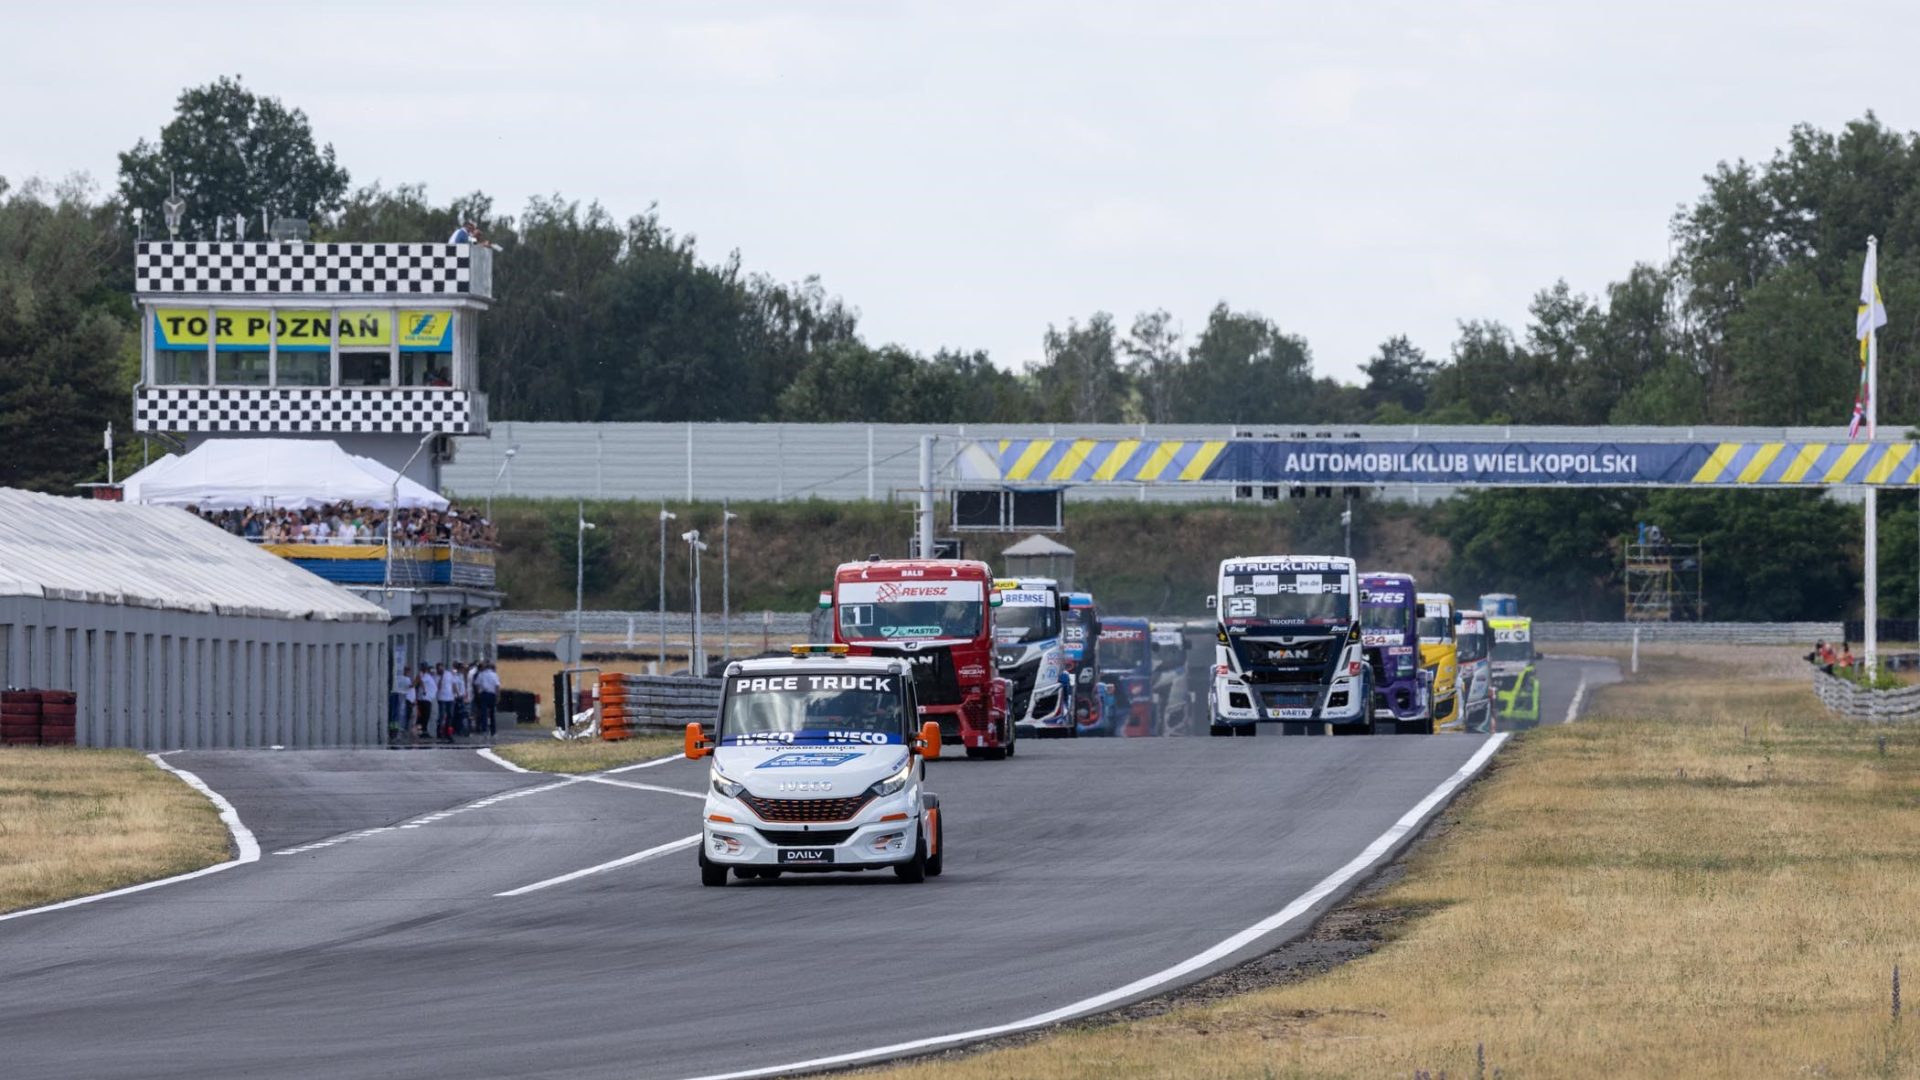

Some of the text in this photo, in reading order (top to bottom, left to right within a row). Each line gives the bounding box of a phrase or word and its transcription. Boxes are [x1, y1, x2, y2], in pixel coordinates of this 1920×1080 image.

[166, 313, 379, 337] TOR POZNAŃ
[1284, 453, 1637, 475] AUTOMOBILKLUB WIELKOPOLSKI
[1236, 563, 1329, 571] TRUCKLINE
[902, 587, 948, 596] REVESZ
[1230, 598, 1255, 615] 23
[853, 607, 861, 624] 1
[1066, 627, 1083, 639] 33
[1268, 650, 1309, 659] MAN
[736, 676, 891, 693] PACE TRUCK
[736, 732, 795, 745] IVECO
[828, 731, 888, 744] IVECO
[779, 781, 832, 792] IVECO
[787, 851, 823, 859] DAILY
